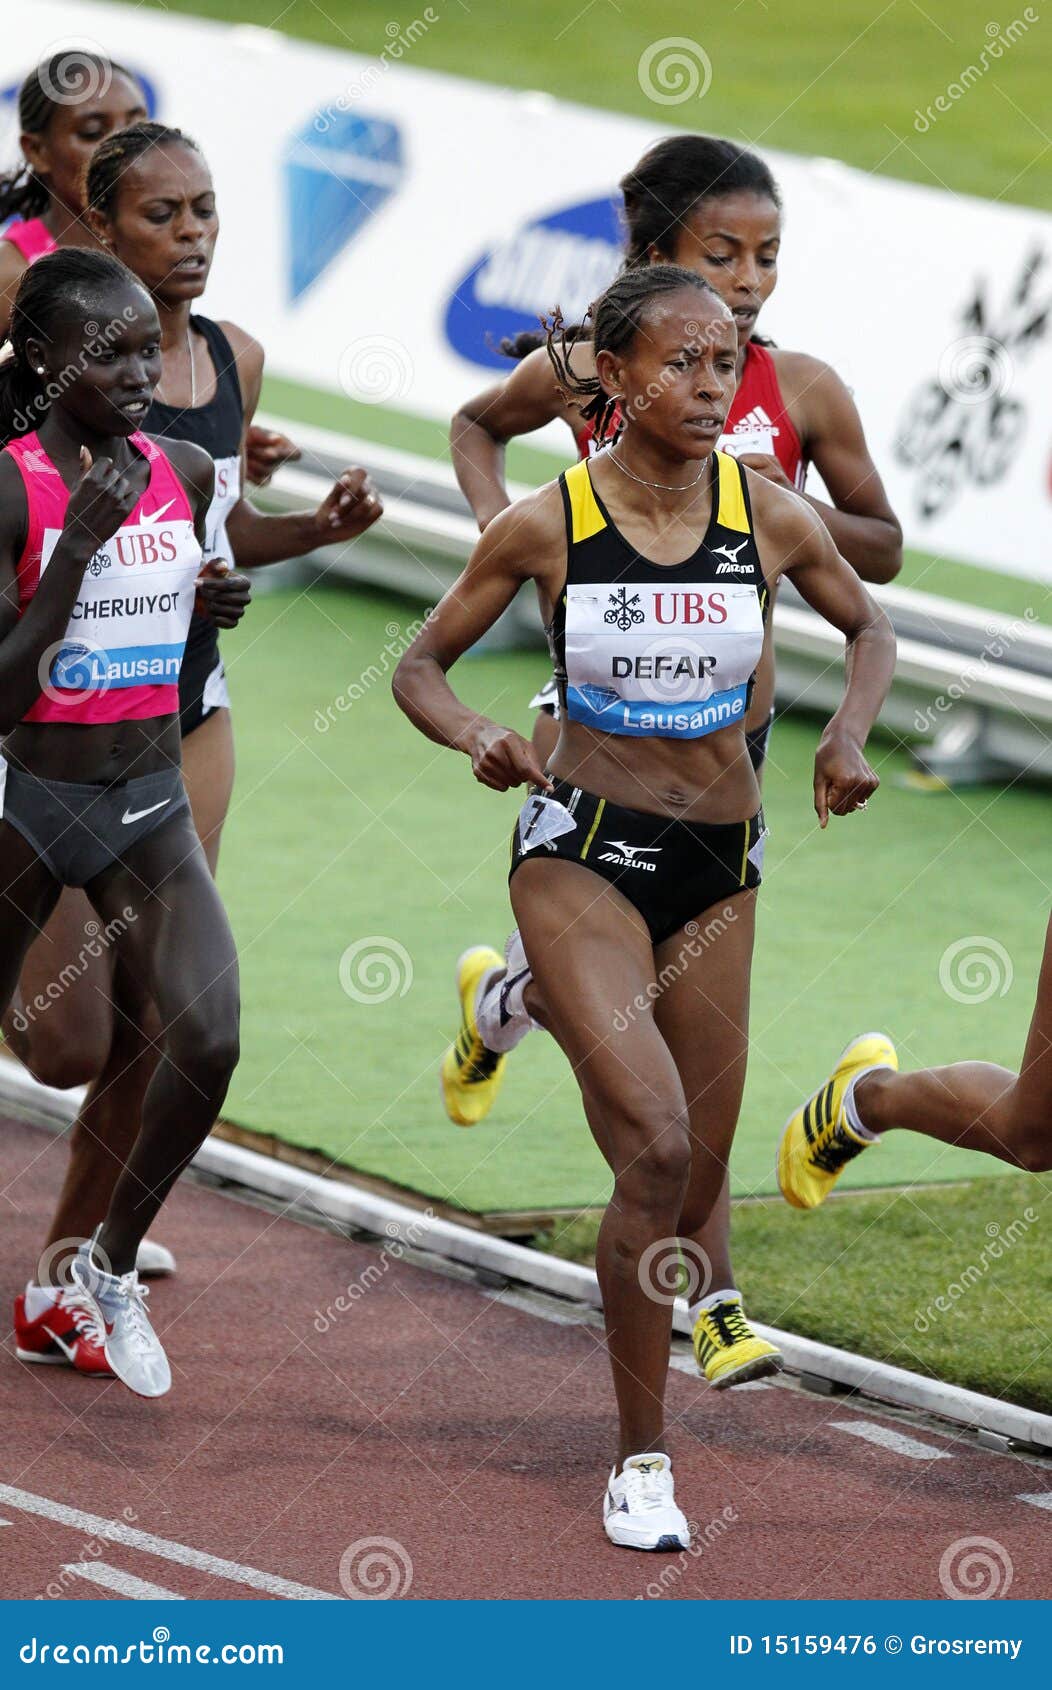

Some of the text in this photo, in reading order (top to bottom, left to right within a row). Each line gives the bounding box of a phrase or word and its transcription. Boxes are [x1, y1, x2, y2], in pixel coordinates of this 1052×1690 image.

[115, 531, 177, 567] UBS
[71, 592, 179, 620] CHERUIYOT
[652, 593, 728, 625] UBS
[612, 656, 717, 680] DEFAR
[623, 697, 744, 731] Lausanne
[524, 800, 546, 840] 7
